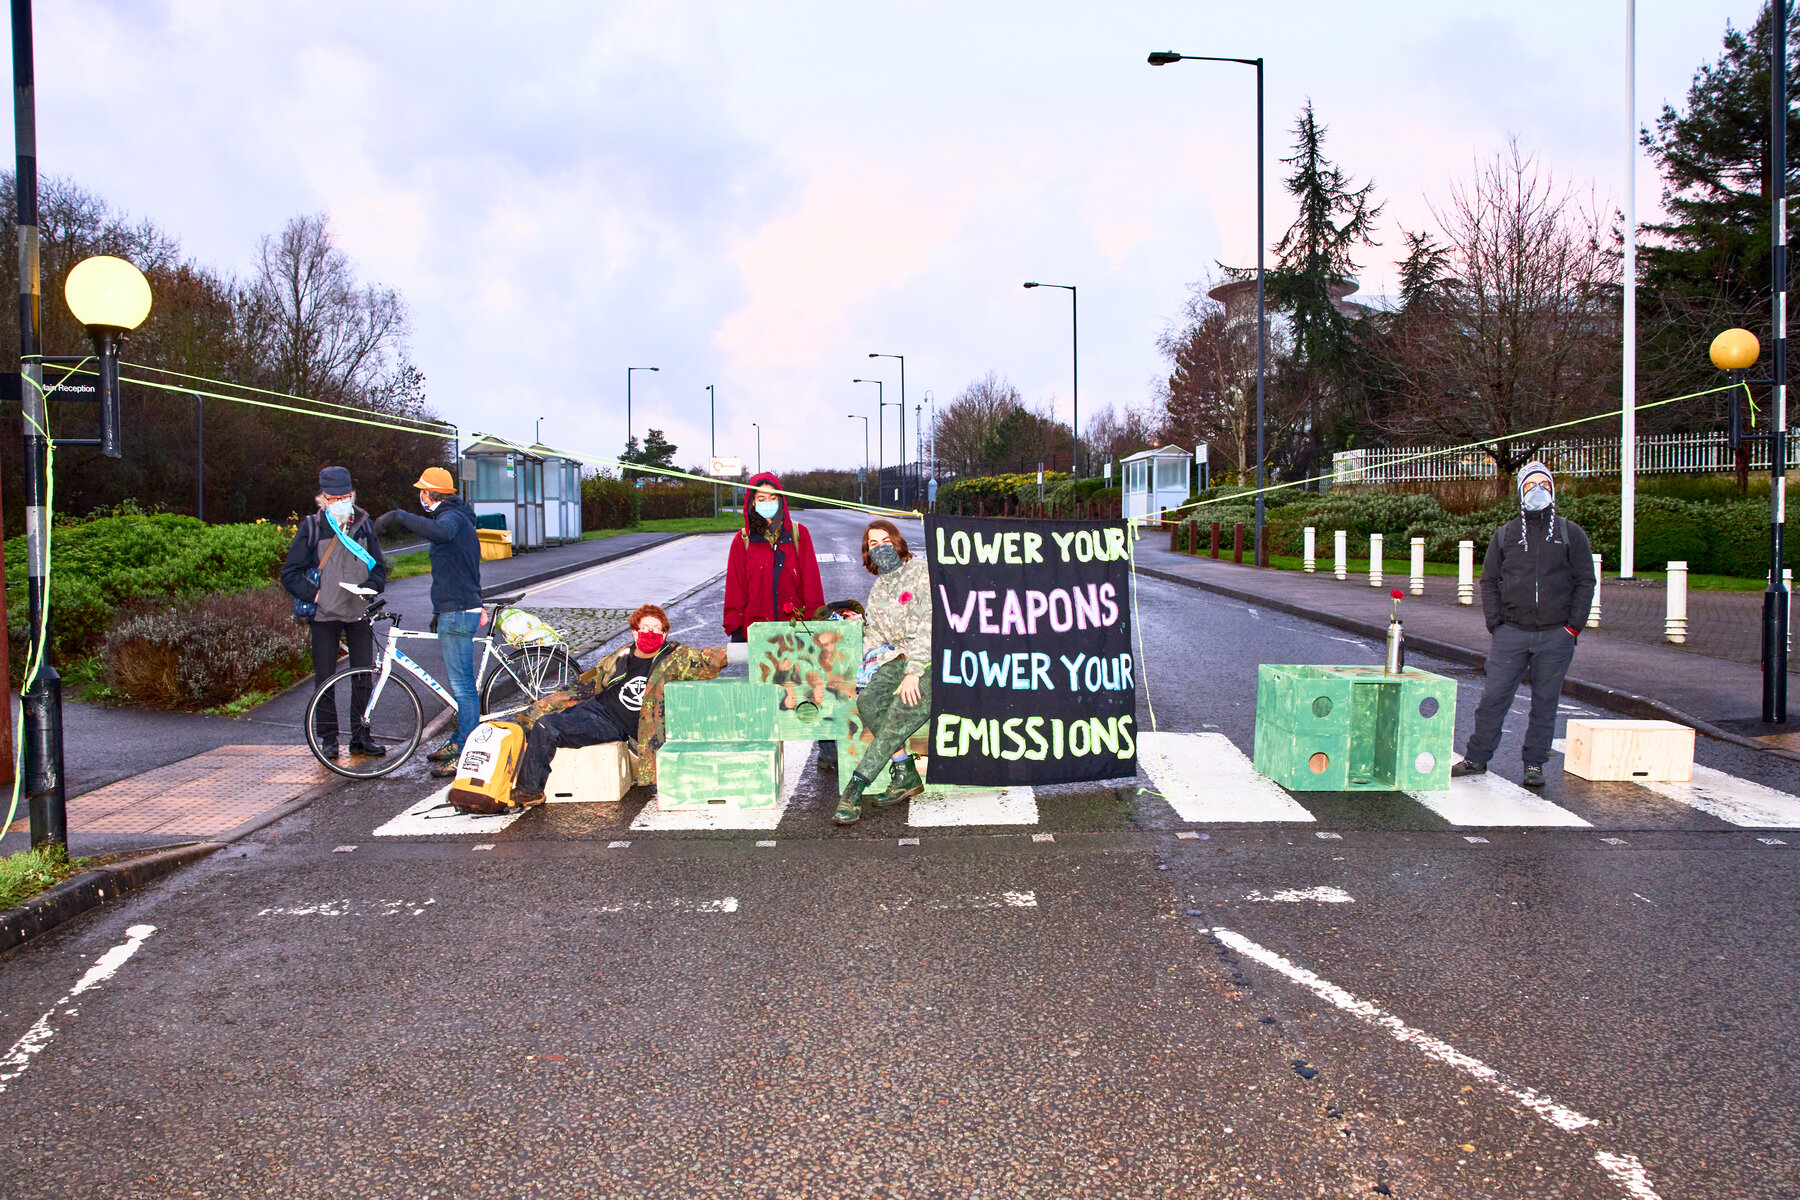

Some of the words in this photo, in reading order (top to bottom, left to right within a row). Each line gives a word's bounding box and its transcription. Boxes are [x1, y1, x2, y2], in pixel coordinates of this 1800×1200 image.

[58, 384, 95, 393] Reception
[936, 527, 1044, 565] LOWER
[1052, 527, 1129, 562] YOUR
[939, 582, 1119, 635] WEAPONS
[942, 648, 1055, 691] LOWER
[1060, 652, 1134, 692] YOUR
[936, 713, 1135, 761] EMISSIONS
